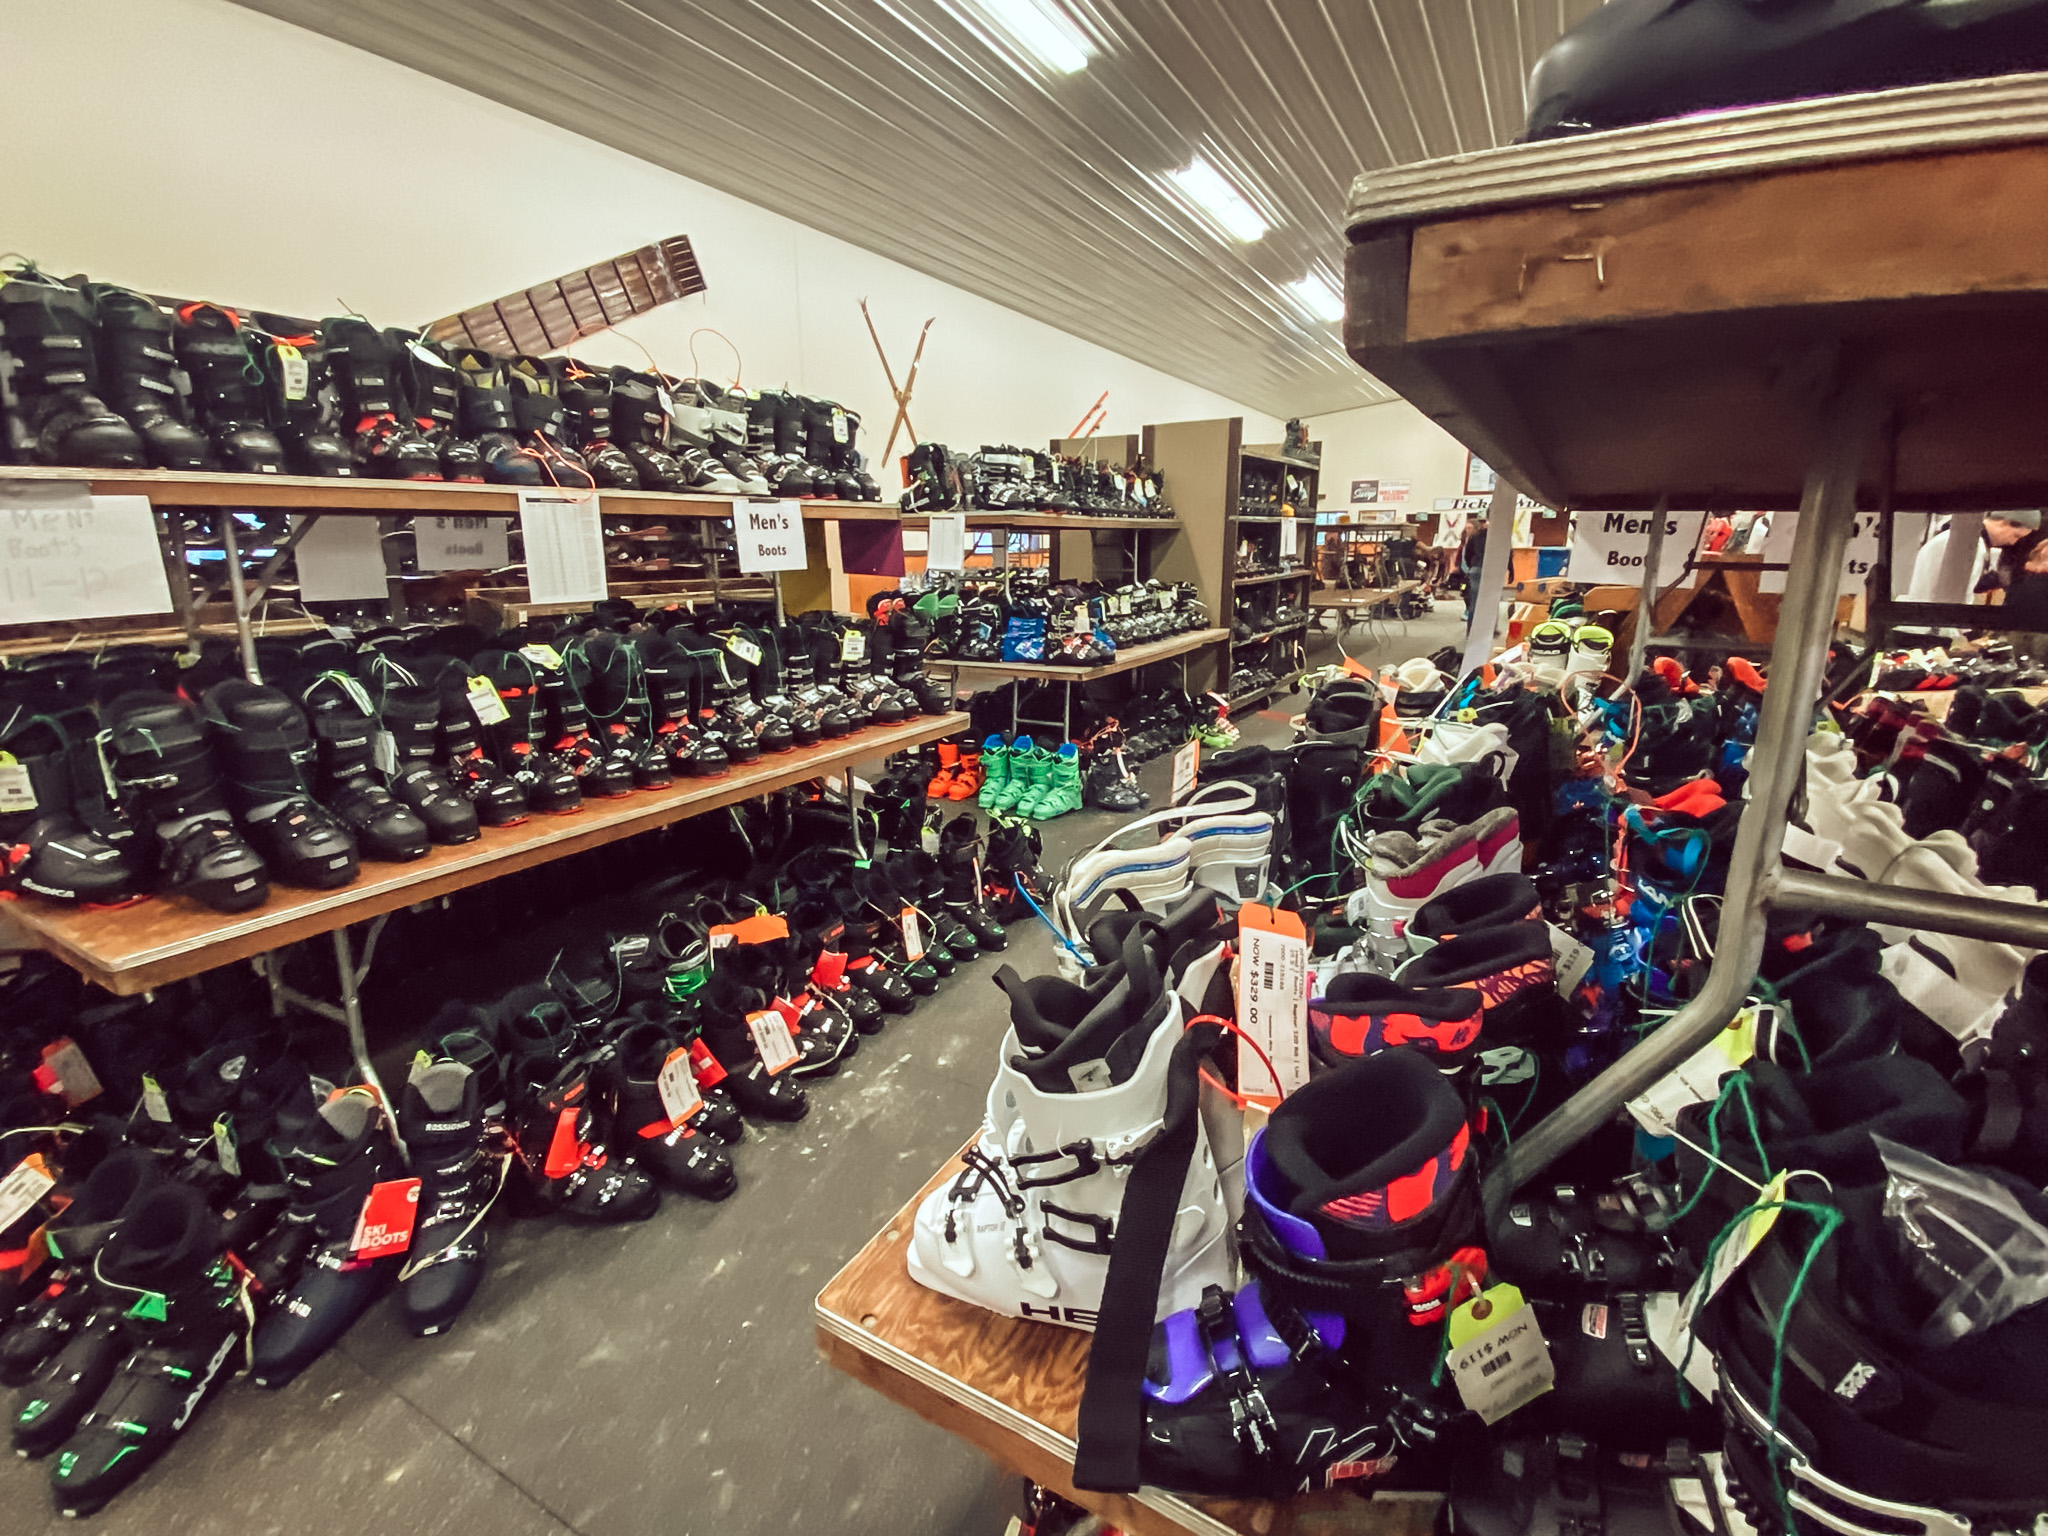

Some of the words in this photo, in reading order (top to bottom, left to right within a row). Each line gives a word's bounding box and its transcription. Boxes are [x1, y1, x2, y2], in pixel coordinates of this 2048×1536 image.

[749, 513, 789, 530] Men's
[1603, 512, 1678, 535] Mens
[758, 544, 787, 557] Boots
[1607, 550, 1644, 567] Boo
[1252, 937, 1260, 967] NOW
[425, 1120, 471, 1132] ROSSIGNOL
[359, 1230, 410, 1249] BOOTS
[363, 1223, 388, 1239] SKI
[1497, 1322, 1529, 1347] NOW
